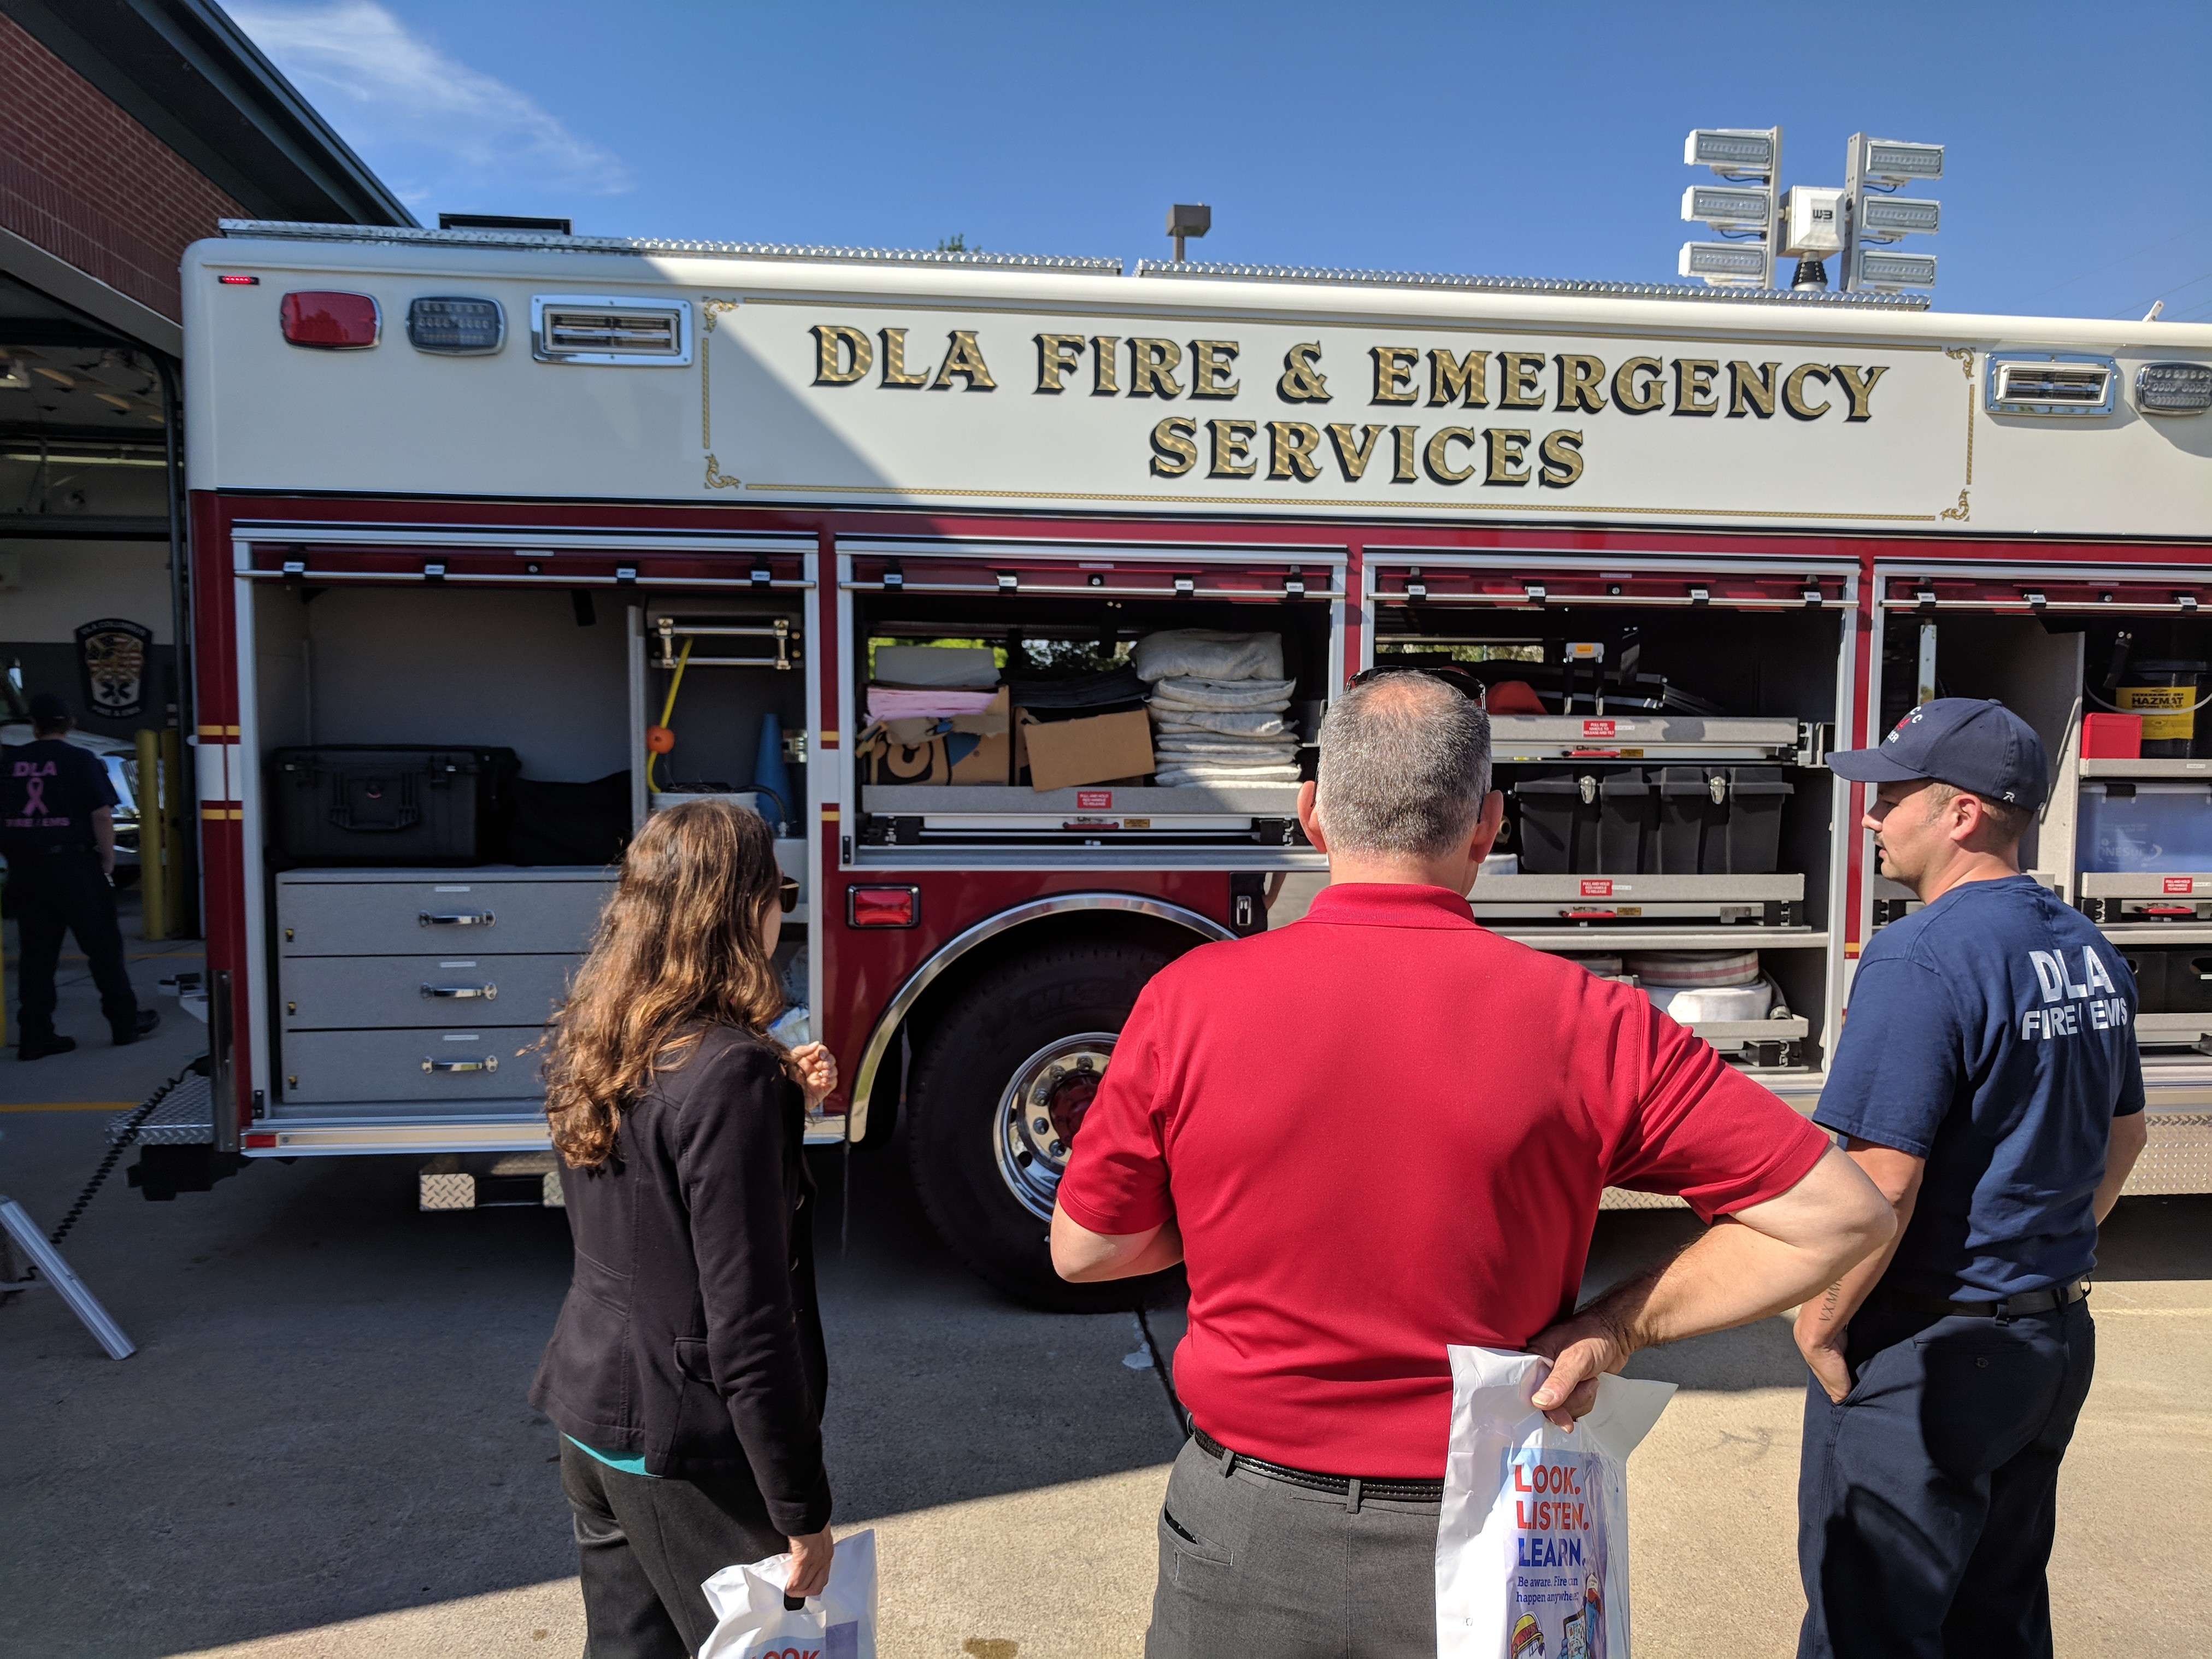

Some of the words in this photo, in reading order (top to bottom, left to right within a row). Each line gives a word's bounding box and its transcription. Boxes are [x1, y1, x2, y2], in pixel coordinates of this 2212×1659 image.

[809, 325, 998, 394] DLA
[1032, 333, 1242, 401] FIRE
[1275, 341, 1333, 405] &
[1368, 346, 1891, 422] EMERGENCY
[1149, 417, 1585, 489] SERVICES
[13, 761, 57, 777] DLA
[2028, 945, 2116, 1003] DLA
[2022, 1004, 2078, 1040] FIRE
[2090, 997, 2127, 1030] EMS
[1514, 1464, 1581, 1495] LOOK.
[1516, 1500, 1589, 1531] LISTEN.
[1518, 1538, 1586, 1567] LEARN.
[1517, 1576, 1528, 1587] Be
[1554, 1575, 1567, 1587] Fire
[1516, 1591, 1546, 1605] happen
